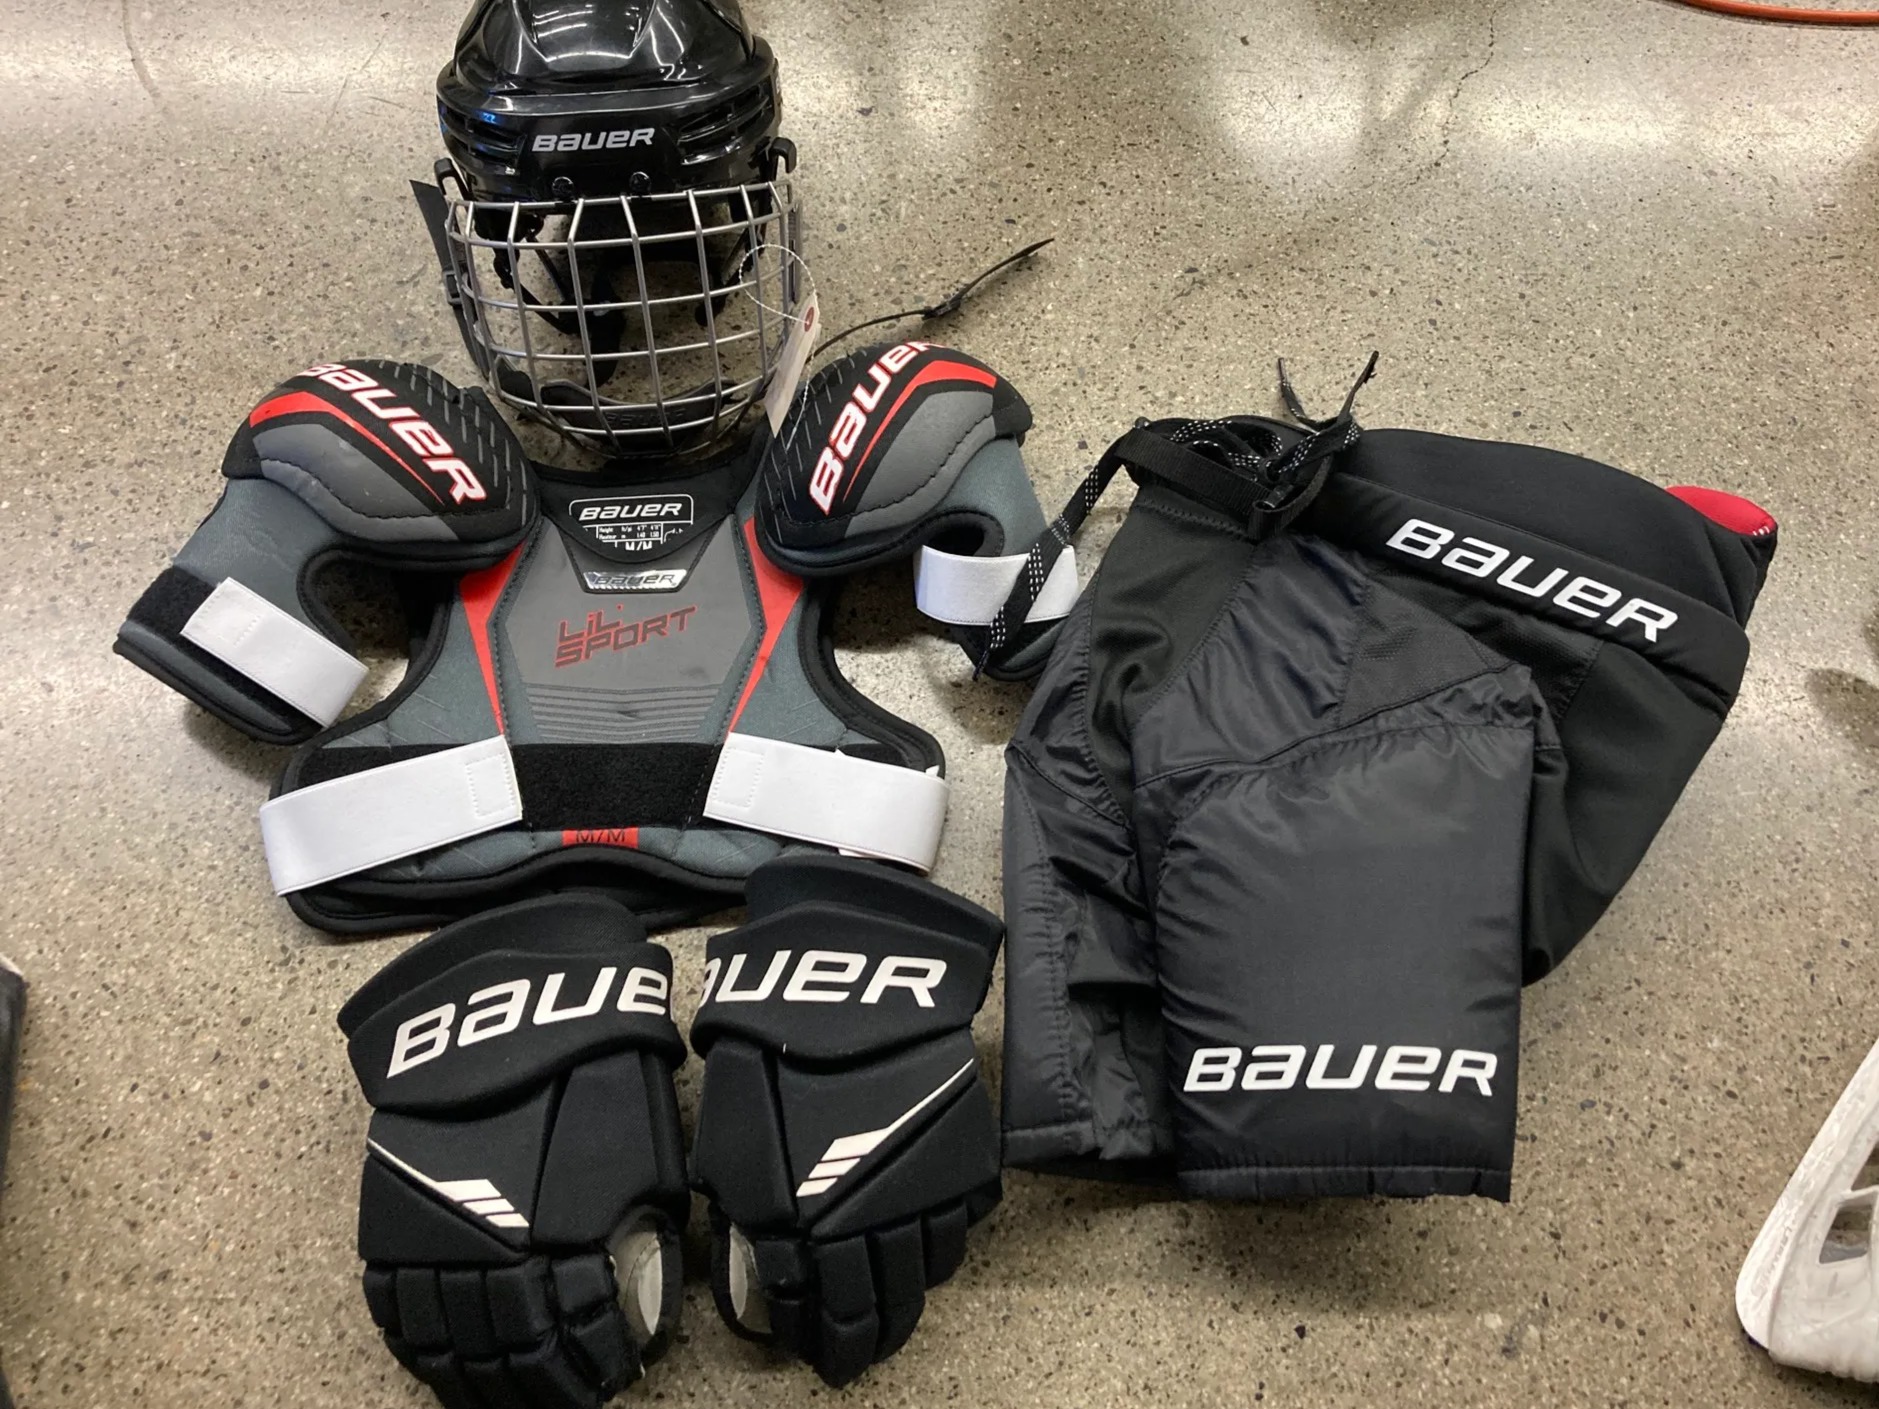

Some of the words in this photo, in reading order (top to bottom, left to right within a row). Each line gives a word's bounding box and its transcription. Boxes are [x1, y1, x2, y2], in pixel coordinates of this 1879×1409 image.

[532, 127, 655, 152] BAUER
[578, 502, 683, 522] BAUER
[594, 573, 676, 585] BAUER
[1385, 517, 1679, 644] BAUER
[554, 604, 698, 669] SPORT
[576, 830, 625, 843] M/M
[1181, 1043, 1499, 1098] BAUER
